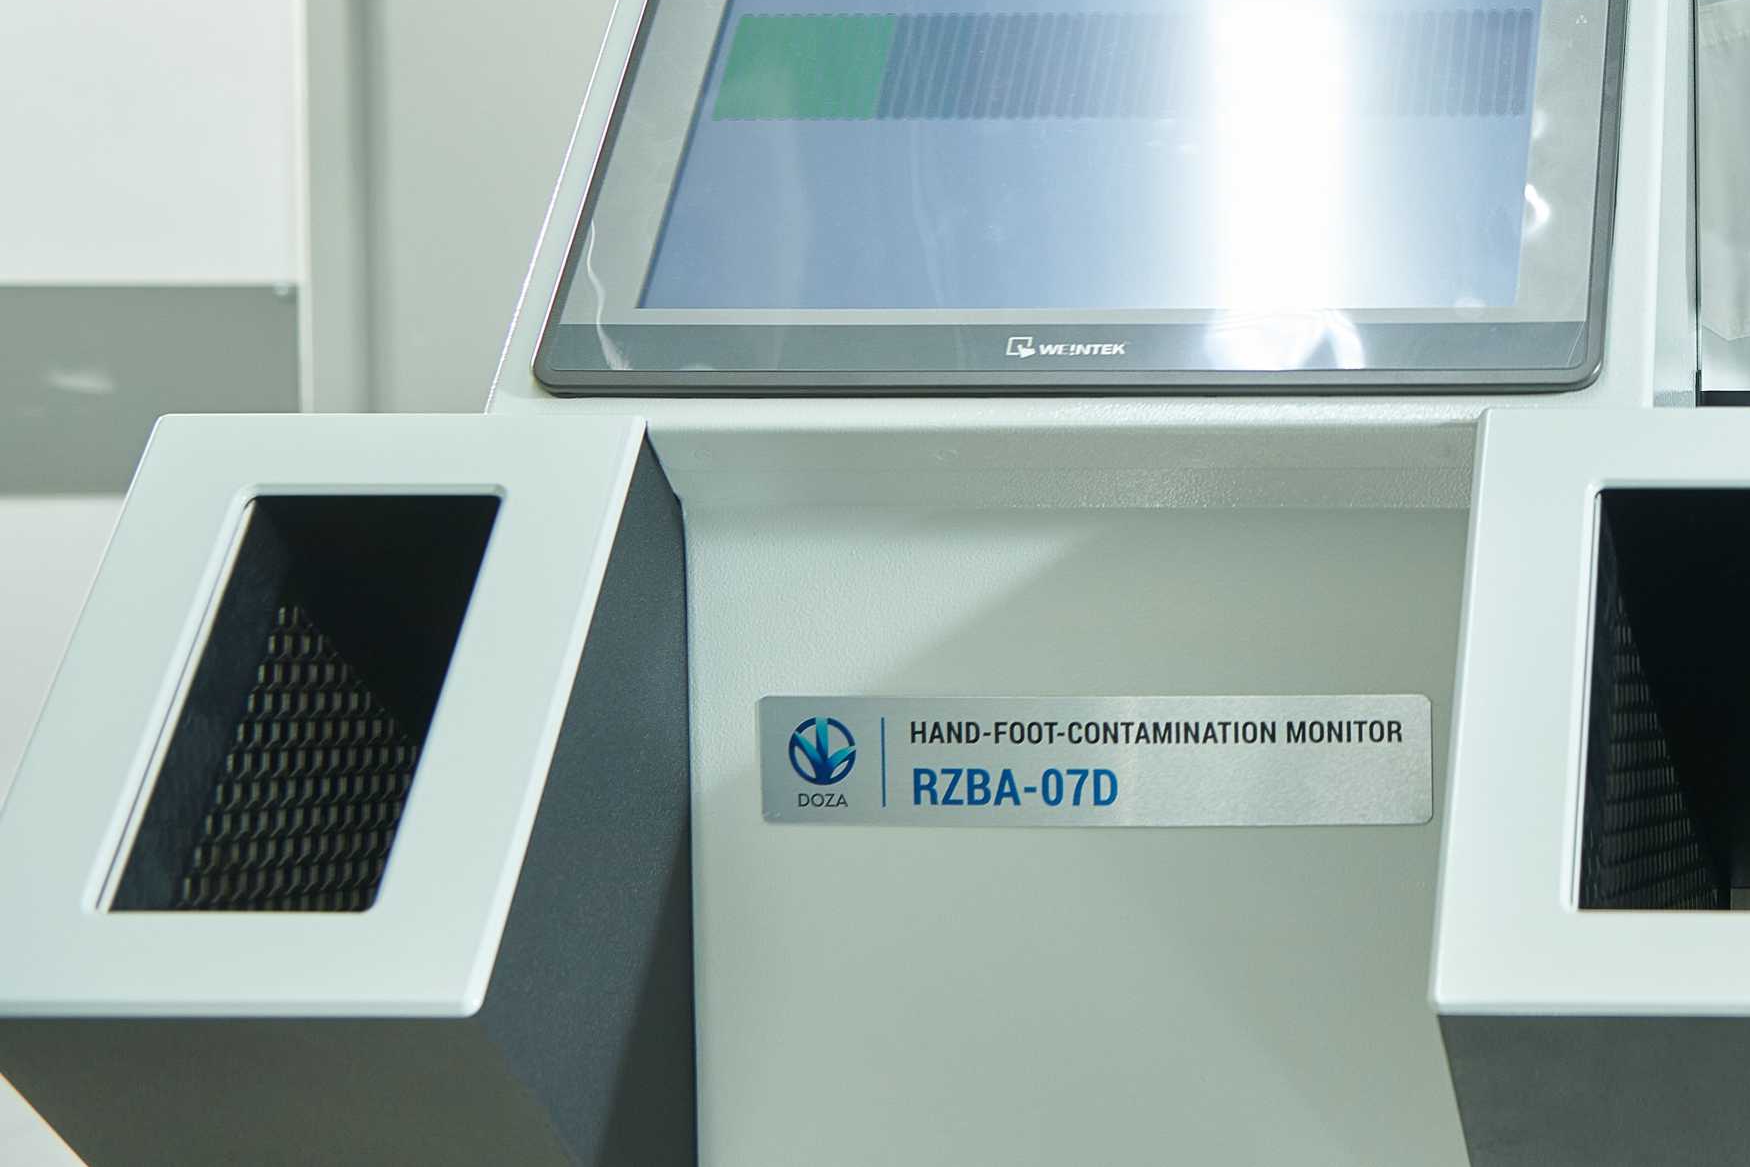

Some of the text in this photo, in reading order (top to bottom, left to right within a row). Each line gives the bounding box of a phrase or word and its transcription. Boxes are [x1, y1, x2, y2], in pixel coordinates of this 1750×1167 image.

[910, 720, 1402, 745] HAND-FOOT-CONTAMINATION MONITOR
[912, 767, 1119, 807] RZBA-07D
[797, 793, 849, 808] DOZA
